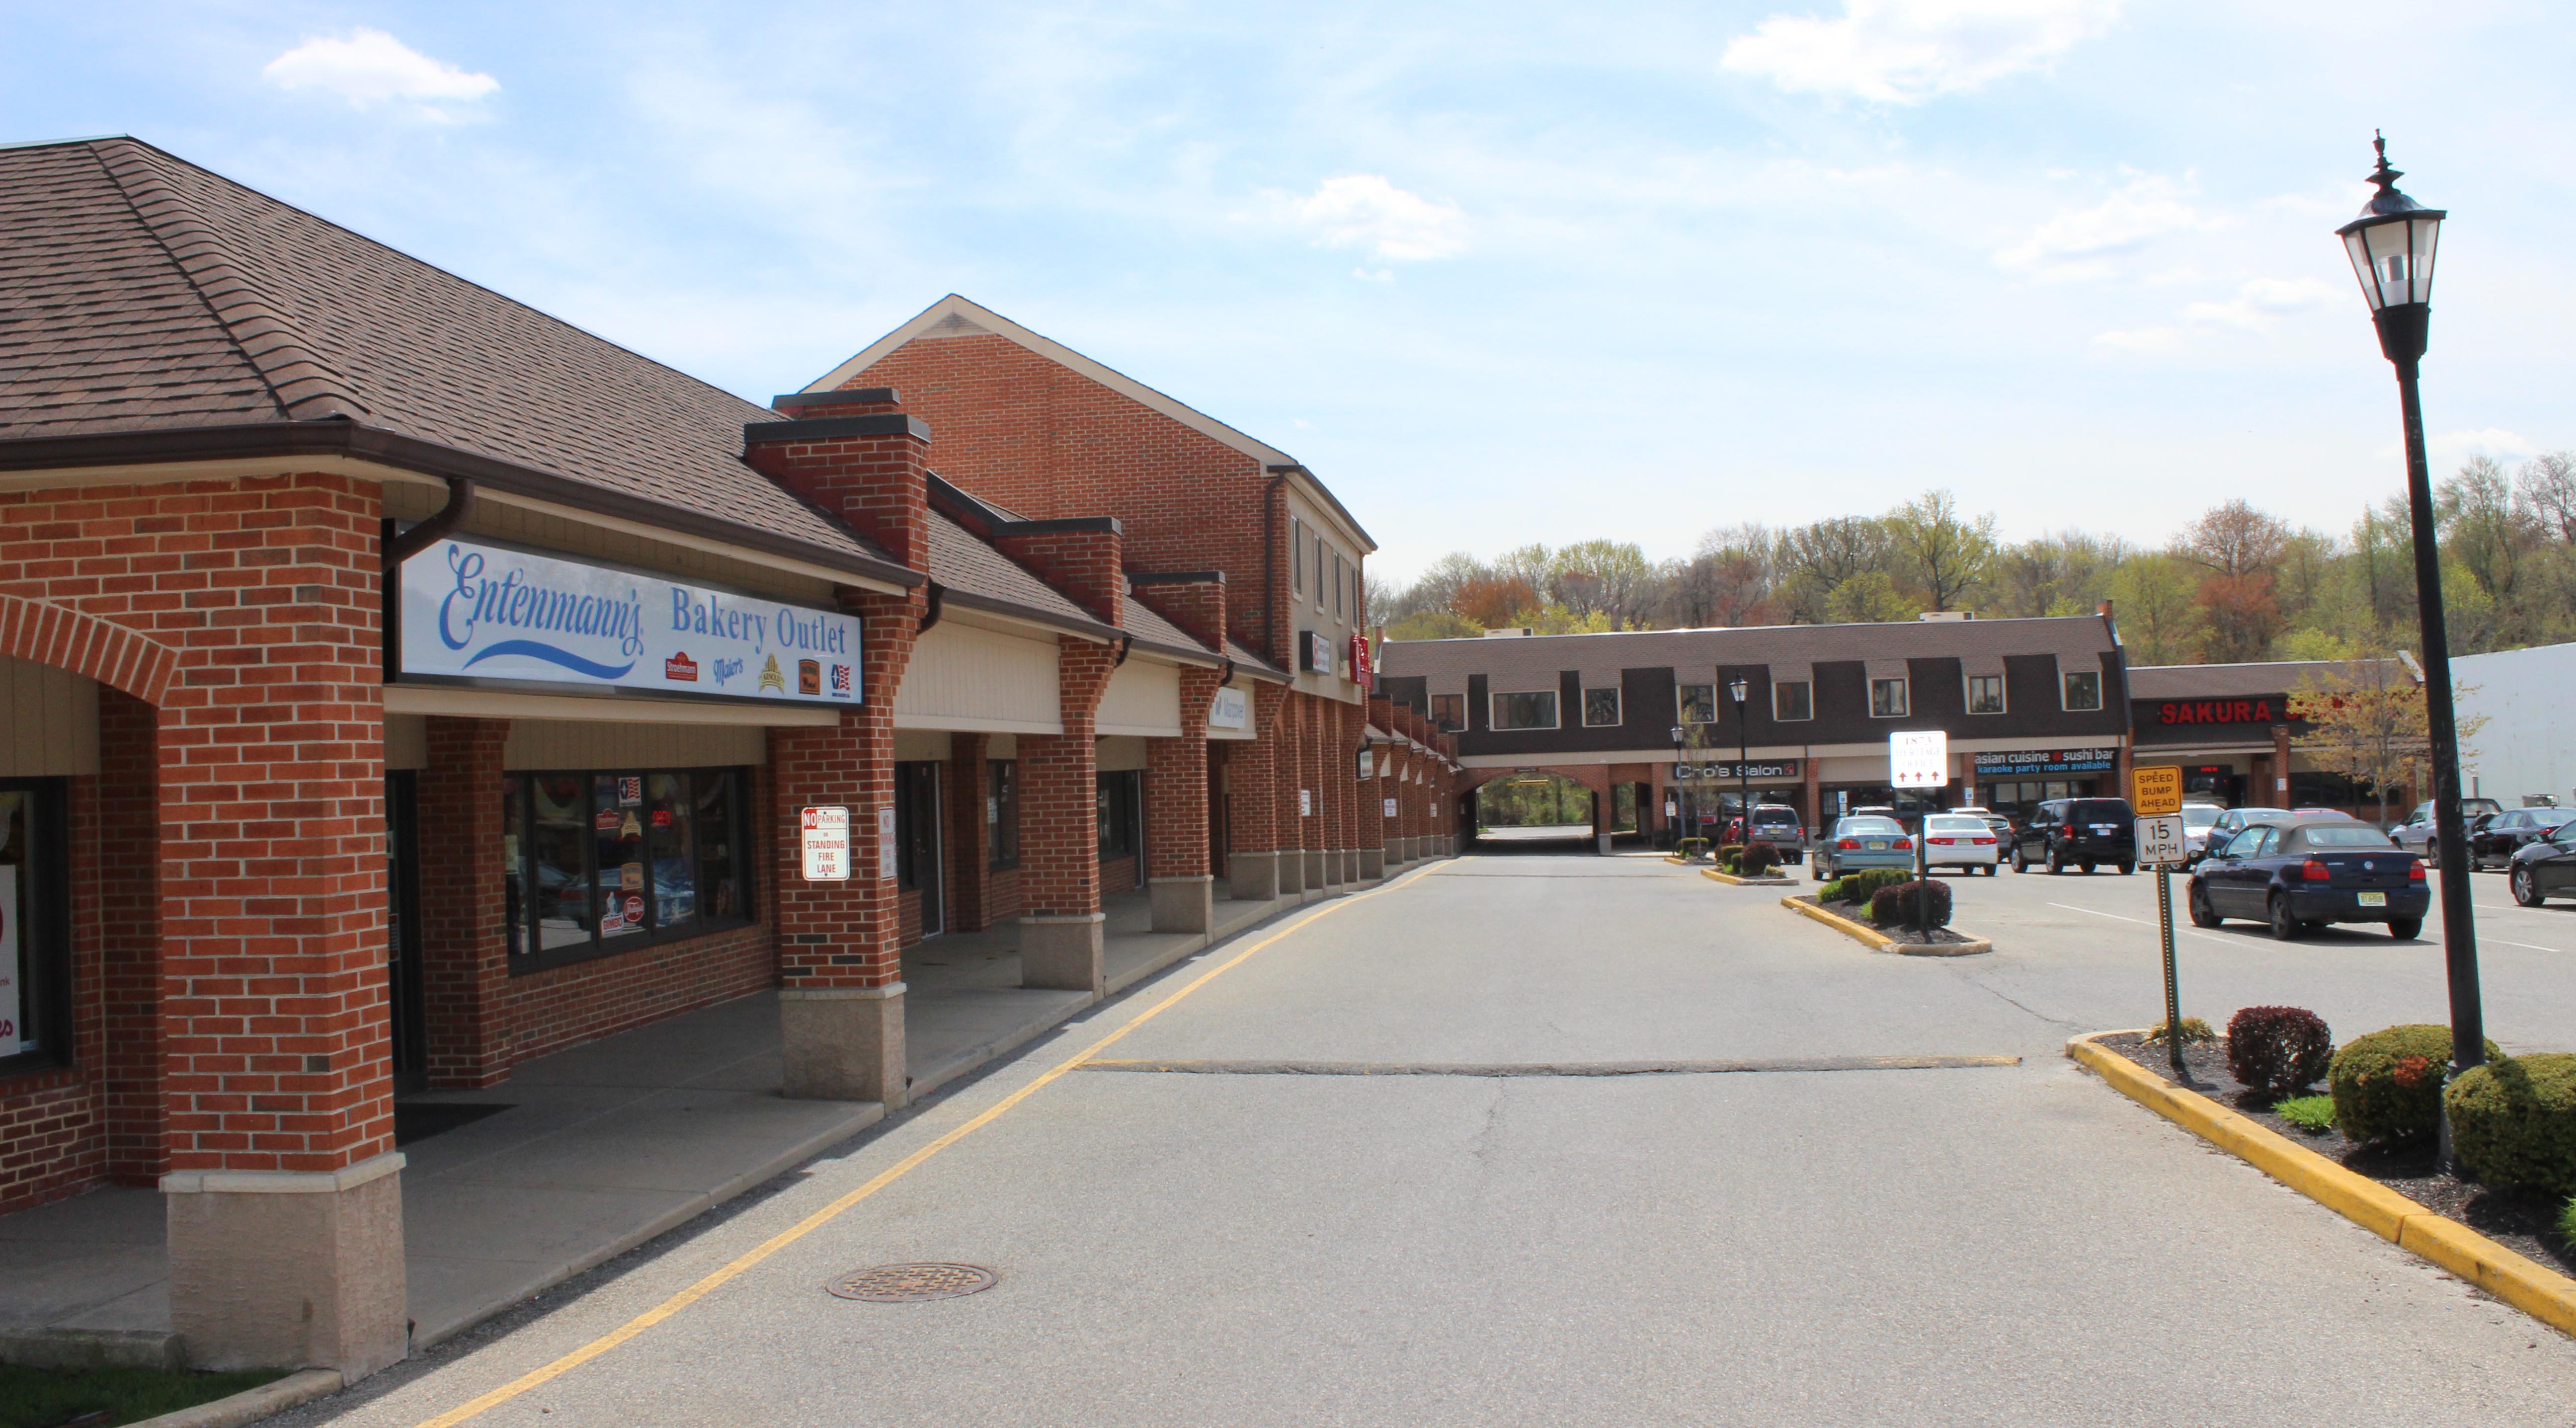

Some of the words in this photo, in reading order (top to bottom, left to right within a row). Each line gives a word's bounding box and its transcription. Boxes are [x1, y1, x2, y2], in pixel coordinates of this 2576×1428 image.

[439, 544, 644, 656] Entenmann's
[671, 587, 767, 654] Bakery
[777, 608, 845, 654] Outlet
[2161, 701, 2271, 723] SAKURA
[1974, 753, 2005, 764] asian
[2008, 751, 2049, 763] cuisine
[2063, 749, 2093, 761] sushi
[2095, 748, 2114, 760] bar
[1736, 764, 1782, 777] Salon
[1977, 765, 2012, 773] karaoke
[2015, 764, 2040, 774] party
[2071, 761, 2111, 770] available
[2139, 774, 2173, 784] SPEED
[2142, 786, 2172, 795] BUMP
[2140, 798, 2175, 808] AHEAD
[804, 812, 816, 826] NO
[818, 815, 845, 823] PARKING
[2150, 824, 2170, 840] 15
[807, 840, 845, 849] STANDING
[2145, 843, 2177, 856] MPH
[818, 852, 834, 861] FIRE
[817, 864, 836, 873] LANE
[603, 917, 622, 930] BIMBO
